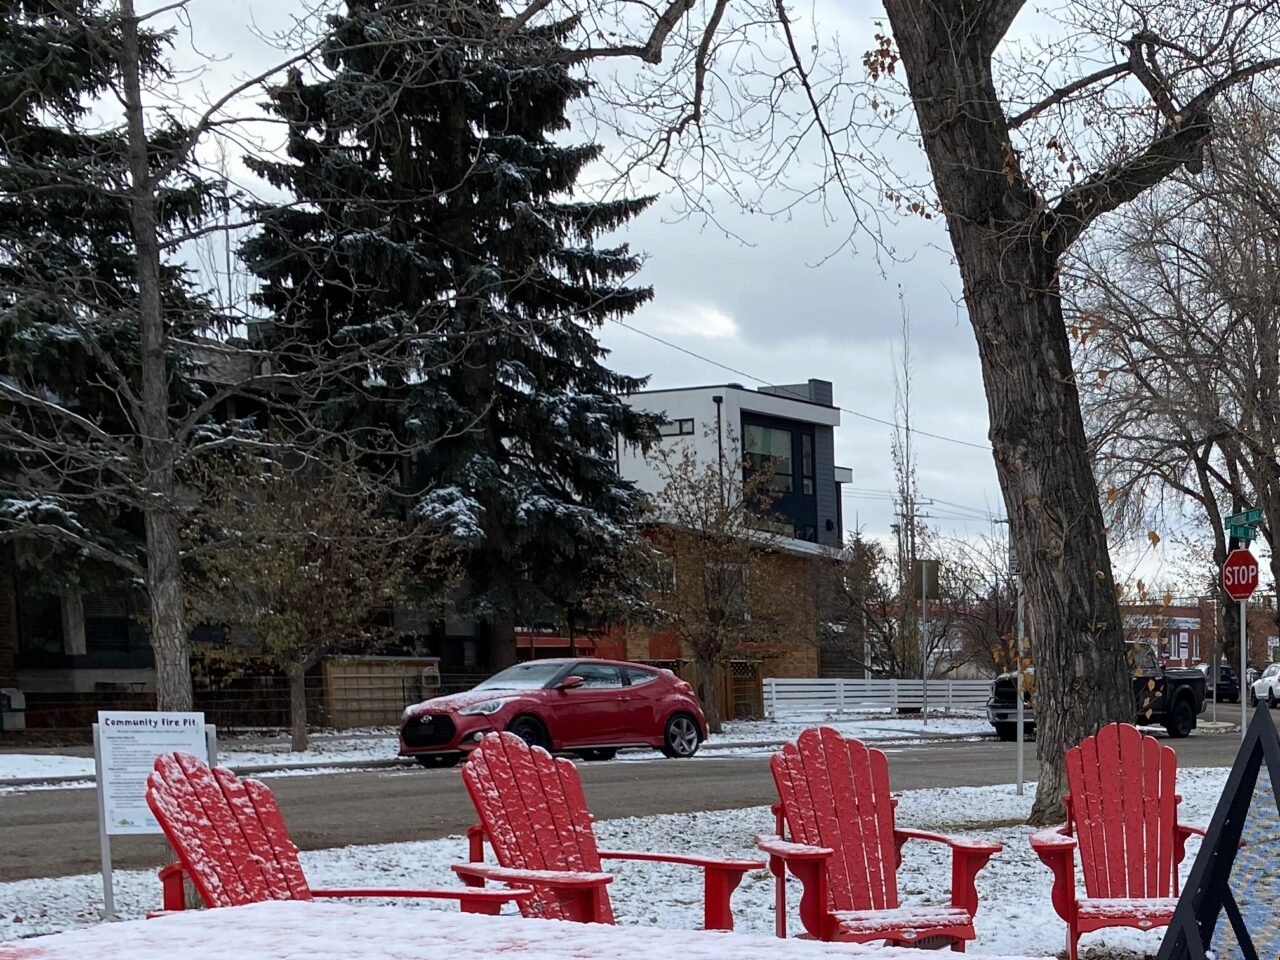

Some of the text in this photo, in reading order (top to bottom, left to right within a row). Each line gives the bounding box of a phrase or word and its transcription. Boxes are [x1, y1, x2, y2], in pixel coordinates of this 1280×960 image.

[1226, 565, 1257, 585] STOP
[105, 718, 196, 728] Community Fire Pit
